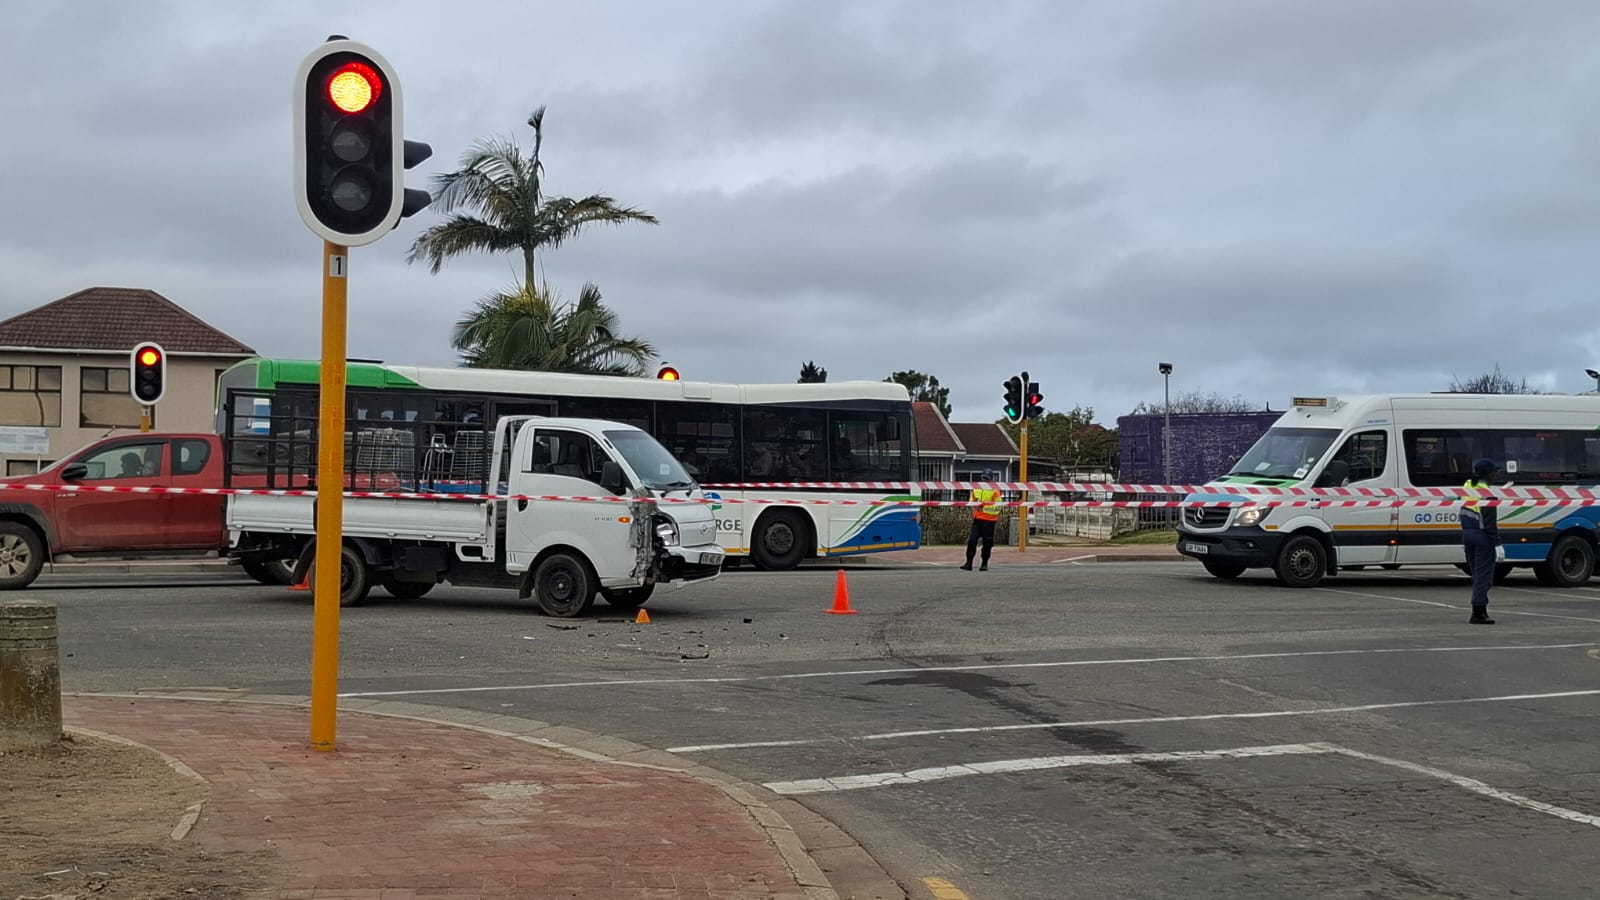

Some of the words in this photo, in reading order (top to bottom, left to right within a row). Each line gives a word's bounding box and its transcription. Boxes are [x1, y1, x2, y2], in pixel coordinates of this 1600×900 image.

[336, 256, 342, 274] 1
[1414, 513, 1432, 523] GO
[1435, 513, 1460, 522] GEO
